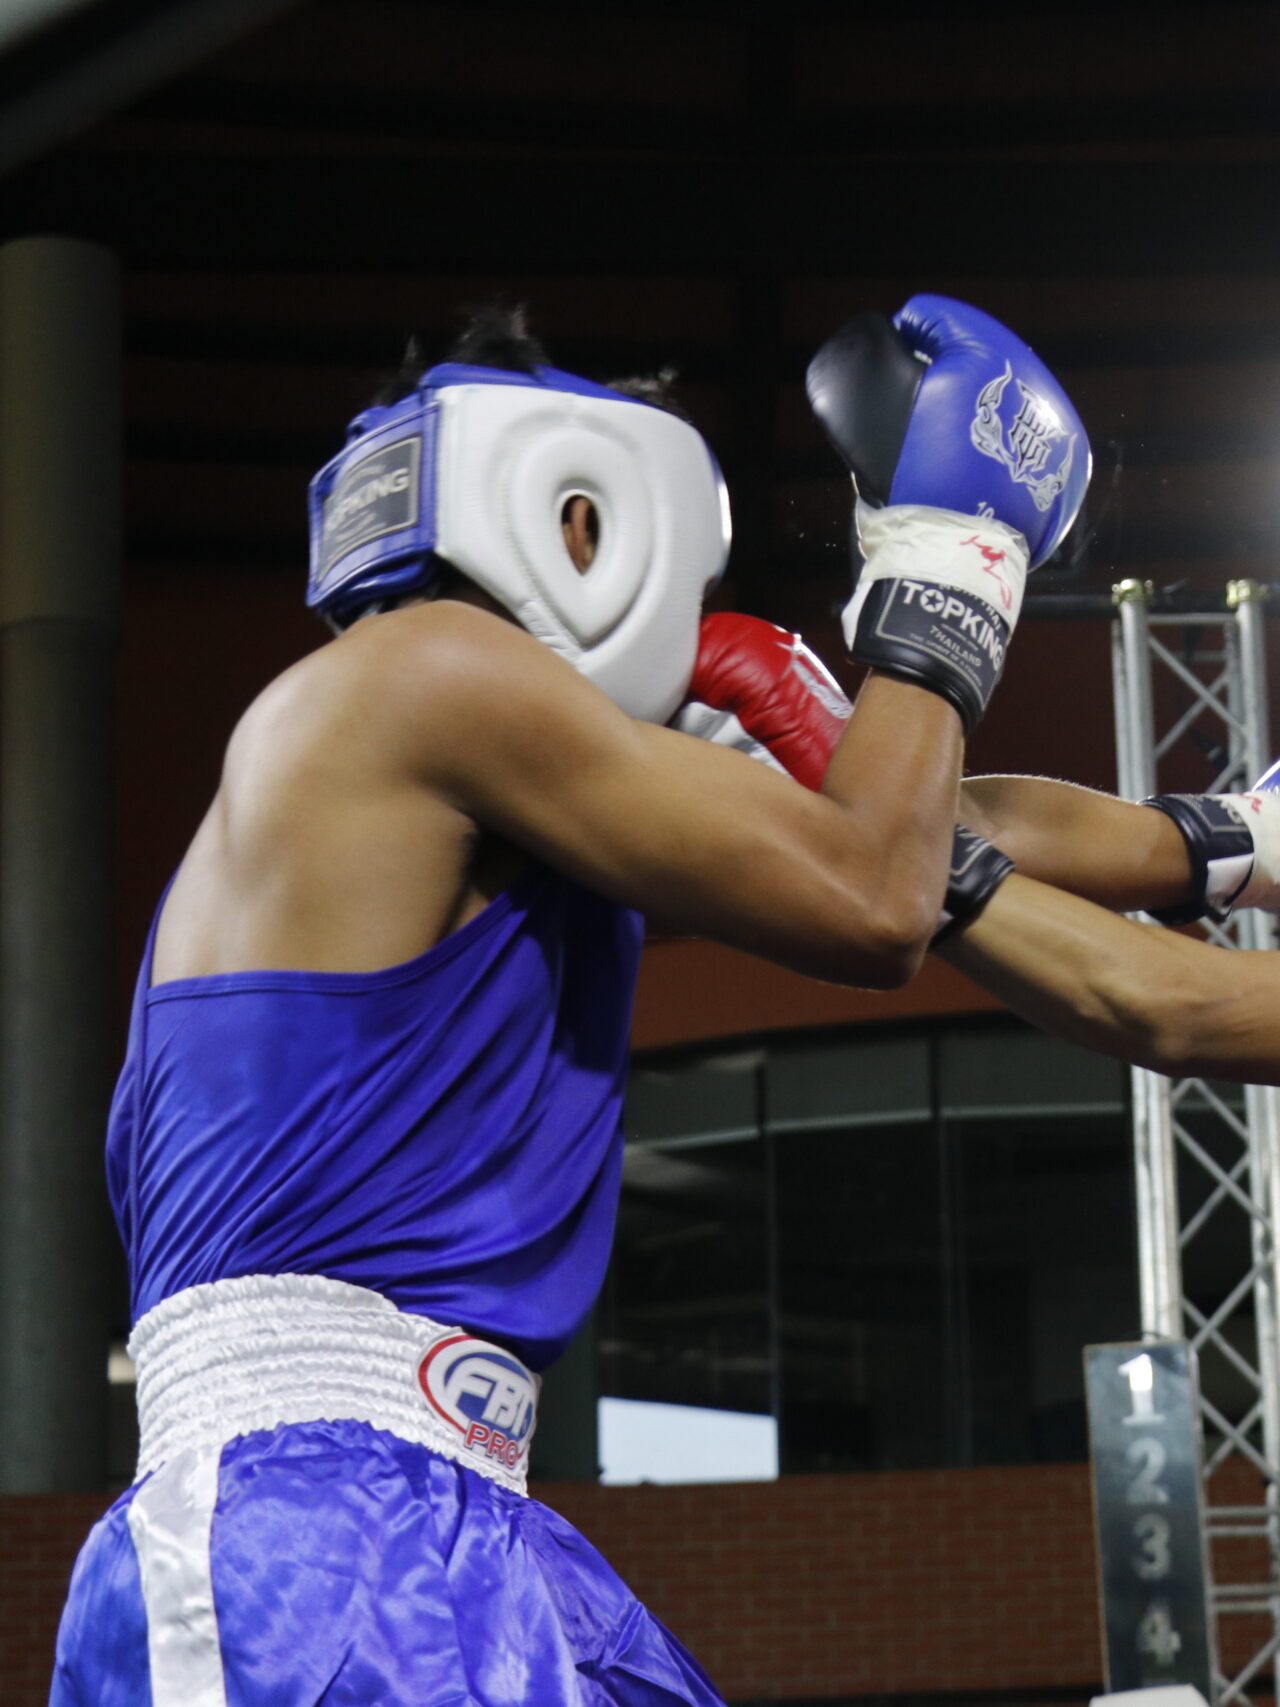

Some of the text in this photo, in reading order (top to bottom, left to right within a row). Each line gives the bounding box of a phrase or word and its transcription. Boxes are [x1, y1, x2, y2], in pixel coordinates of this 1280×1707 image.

[901, 580, 1003, 671] TOPKING
[929, 625, 982, 667] THAILAND
[1117, 1353, 1167, 1427] 1
[464, 1421, 519, 1469] PRO
[1125, 1437, 1169, 1505] 2
[1132, 1513, 1170, 1580] 3
[1137, 1605, 1181, 1665] 4
